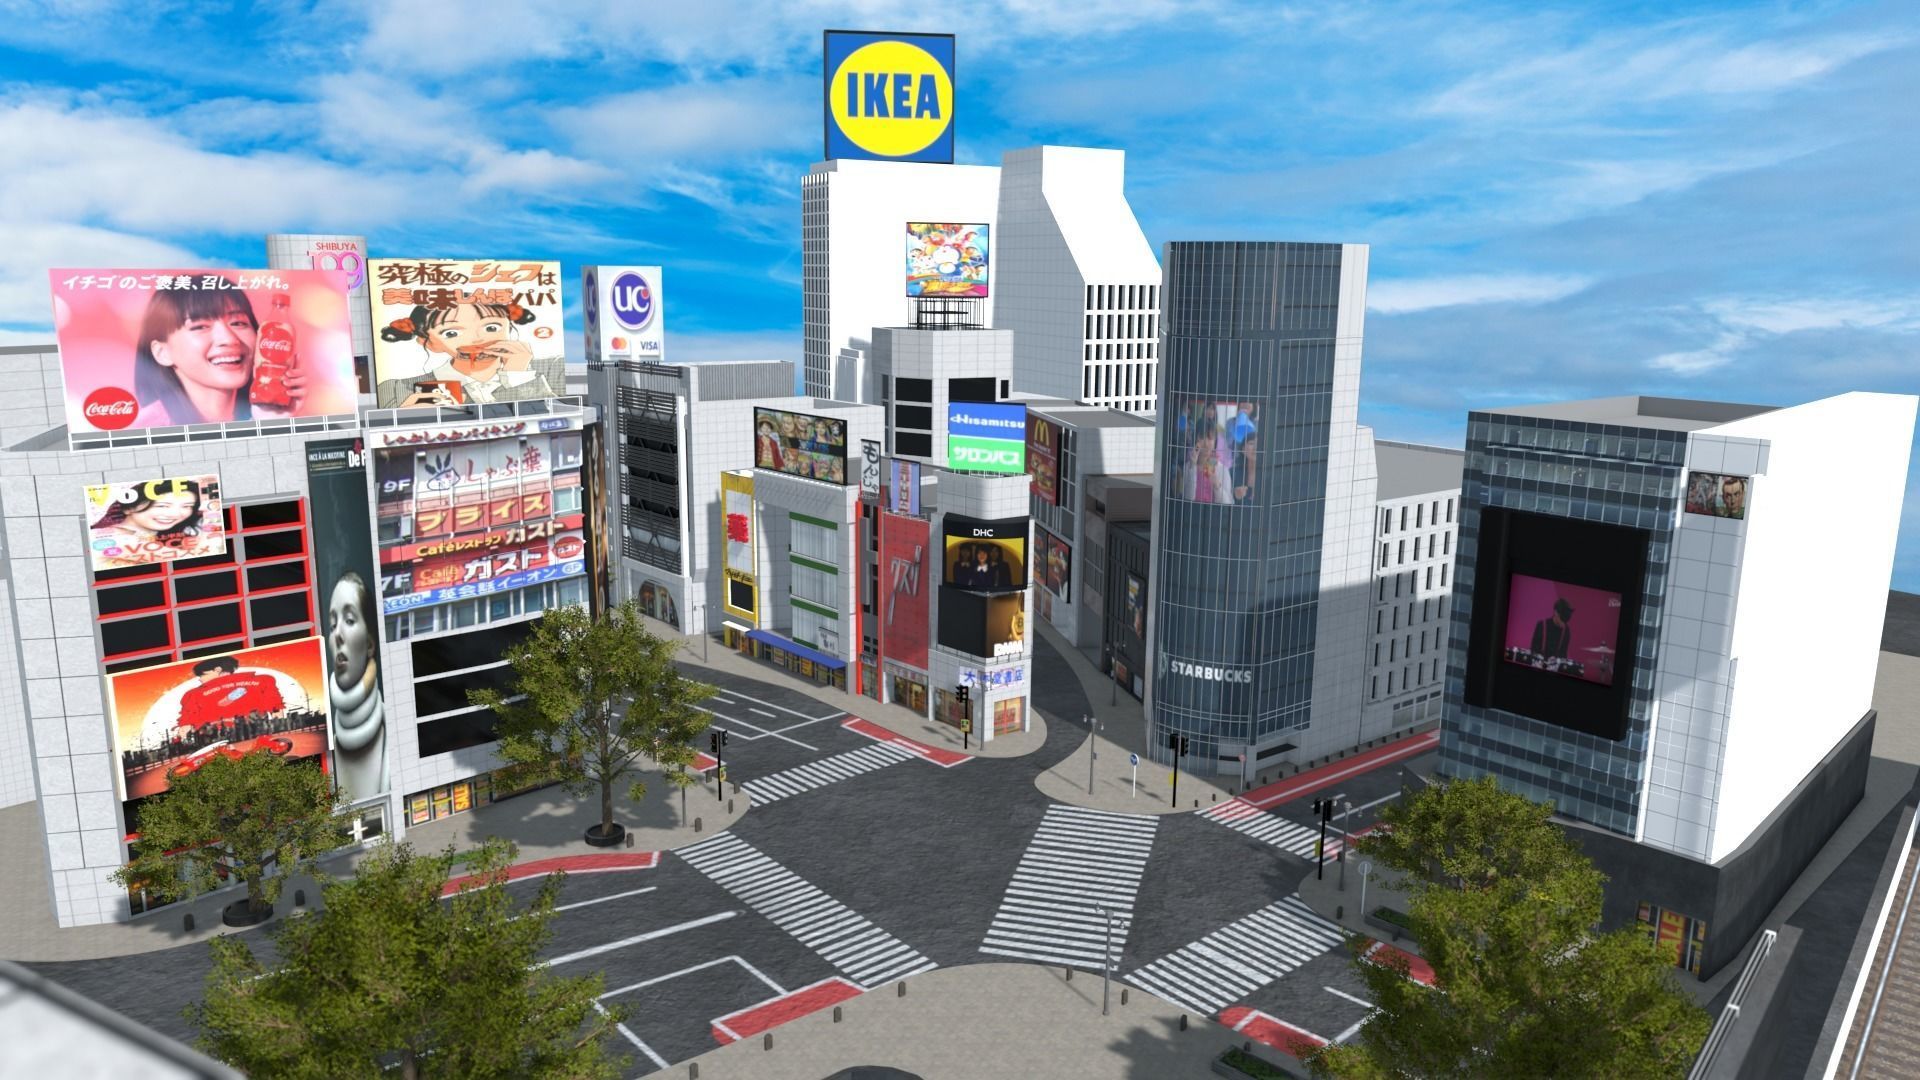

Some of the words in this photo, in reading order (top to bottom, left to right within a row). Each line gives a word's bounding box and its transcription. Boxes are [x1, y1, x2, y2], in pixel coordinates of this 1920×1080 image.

[847, 72, 941, 120] IKEA
[316, 242, 357, 251] SHIBUYA
[63, 274, 290, 291] イチゴのご褒美、召し上がれ。
[378, 262, 557, 286] 究極のシェフは
[382, 287, 557, 311] 美味しんぼパパ
[640, 341, 658, 350] VISA
[85, 400, 136, 417] Coca-Cola
[384, 478, 411, 492] 9F
[973, 528, 994, 537] DHC
[1171, 660, 1252, 683] STARBUCKS
